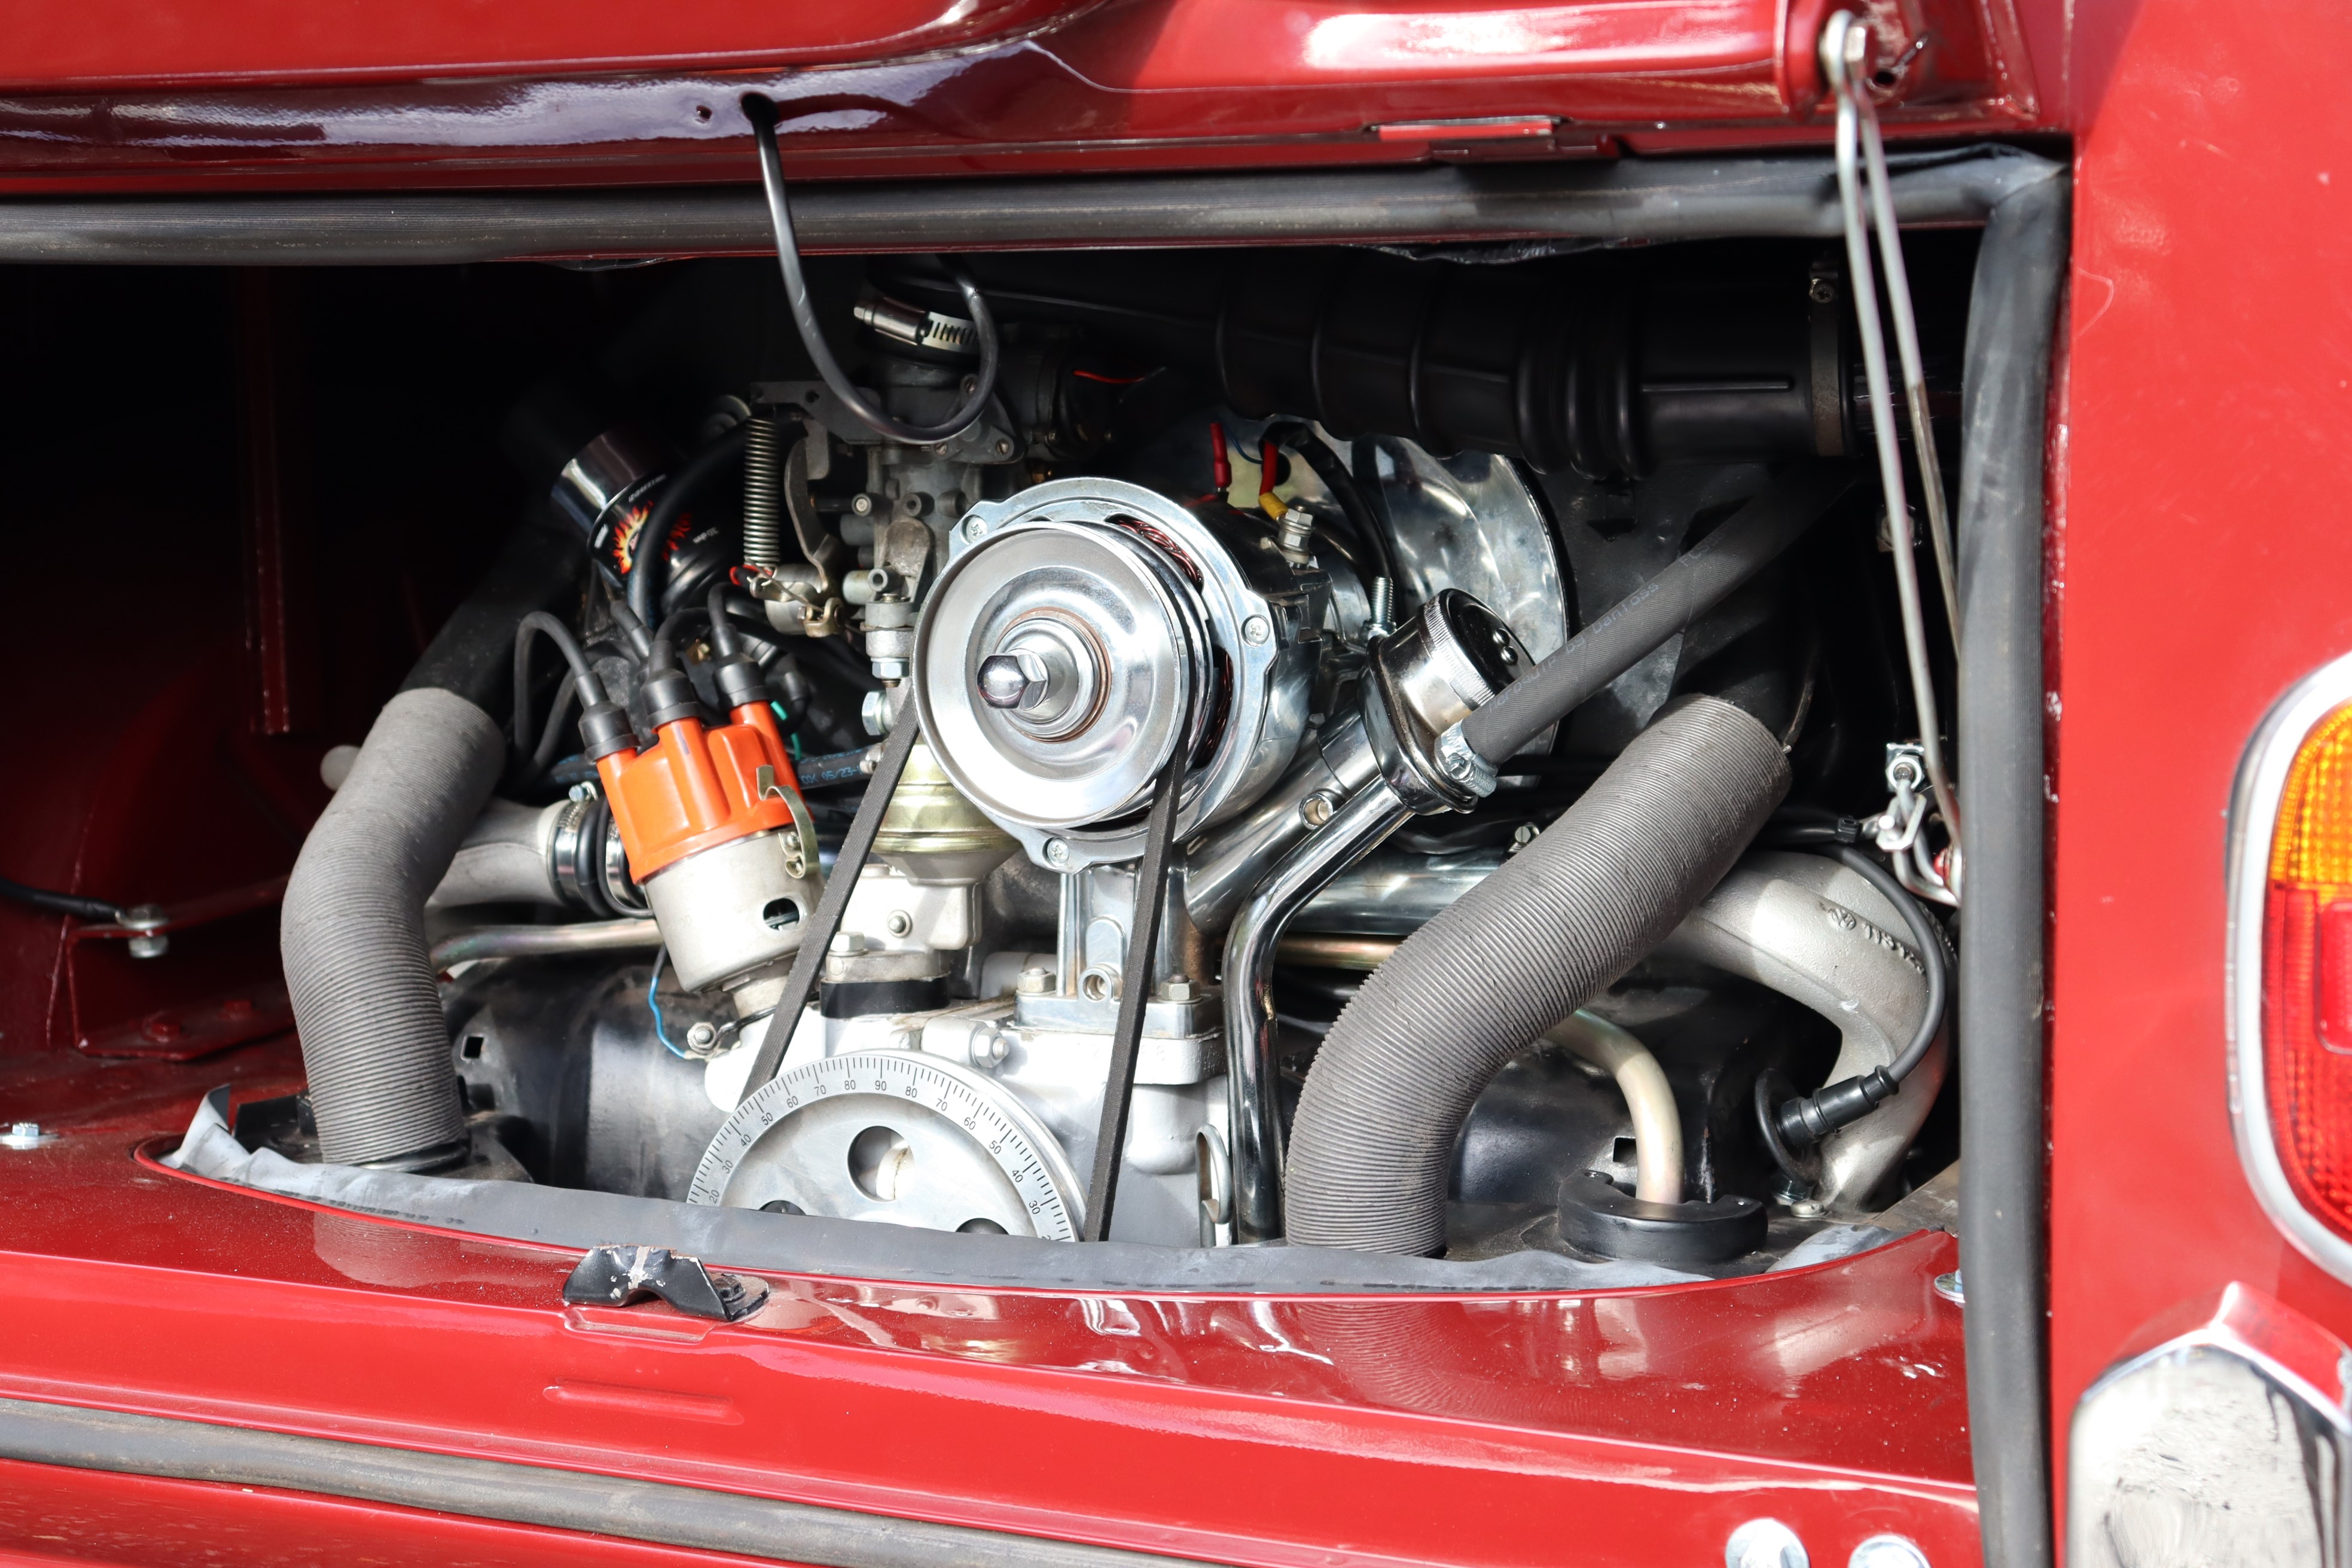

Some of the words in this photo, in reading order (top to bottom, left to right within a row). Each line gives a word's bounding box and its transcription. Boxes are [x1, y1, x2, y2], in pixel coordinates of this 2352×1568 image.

[1591, 582, 1659, 635] Danfoss
[709, 1189, 719, 1204] 20
[722, 1160, 733, 1174] 30
[740, 1134, 752, 1147] 40
[761, 1112, 774, 1126] 50
[786, 1096, 799, 1109] 60
[813, 1085, 827, 1097] 70
[844, 1079, 856, 1091] 80
[875, 1080, 887, 1091] 90
[905, 1085, 918, 1099] 80
[936, 1098, 948, 1111] 70
[963, 1117, 976, 1130] 60
[989, 1140, 1002, 1155] 50
[1012, 1170, 1023, 1183] 40
[1029, 1200, 1041, 1215] 30
